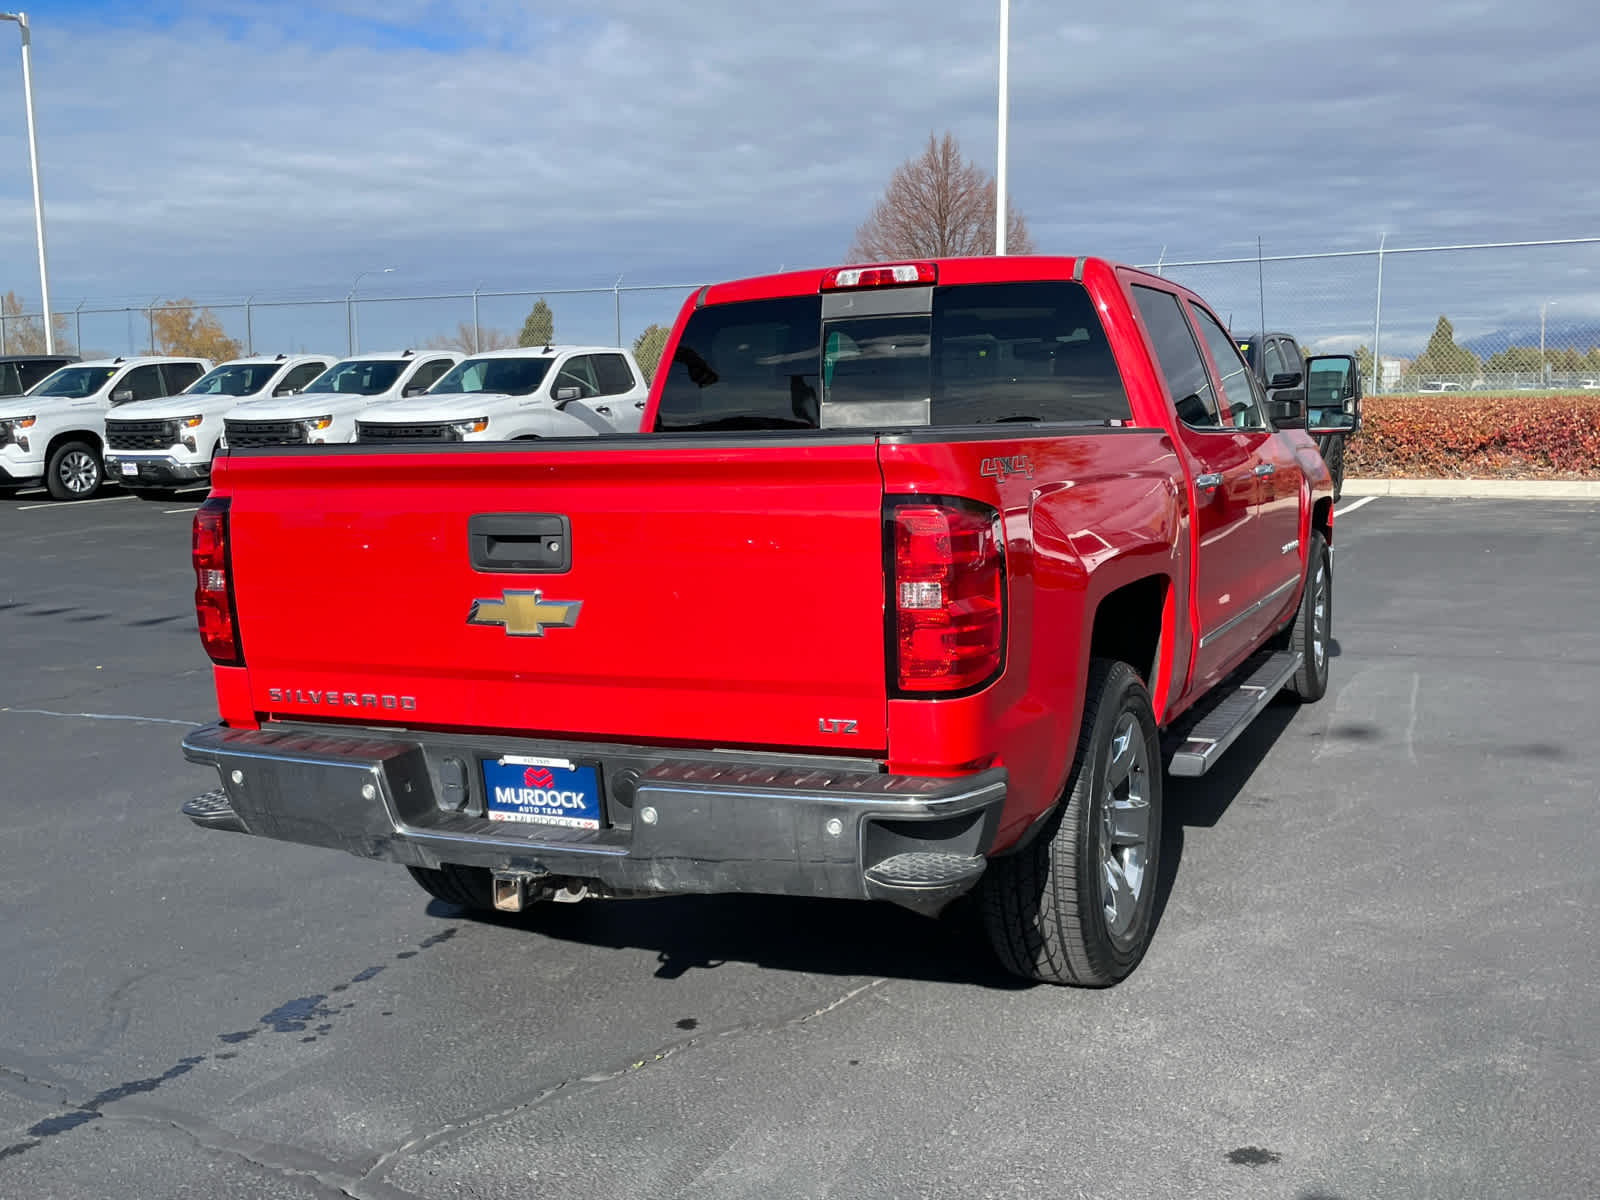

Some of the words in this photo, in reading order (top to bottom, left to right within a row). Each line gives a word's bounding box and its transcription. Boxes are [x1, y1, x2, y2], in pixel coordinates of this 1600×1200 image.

[268, 688, 417, 711] SILVERADO
[819, 718, 858, 734] LTZ
[494, 786, 587, 810] MURDOCK
[518, 806, 540, 814] AUTO
[542, 807, 564, 816] TEAM
